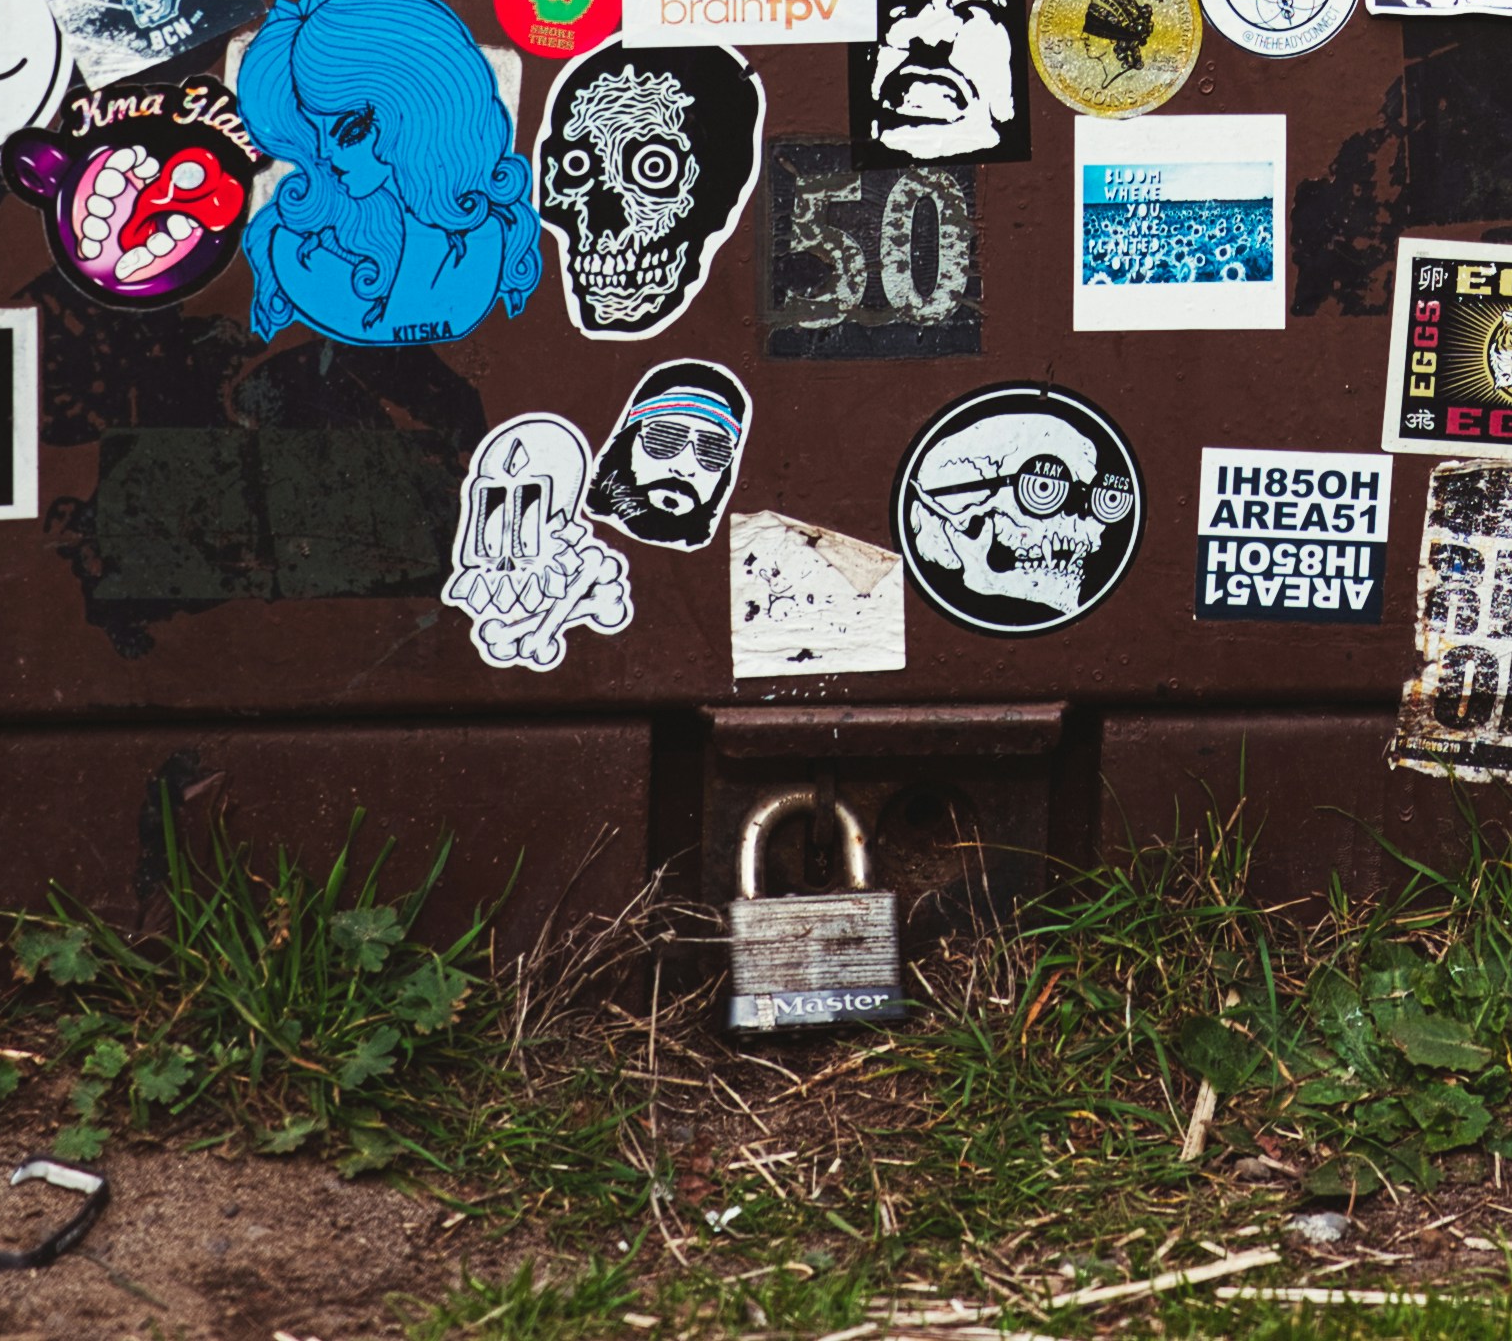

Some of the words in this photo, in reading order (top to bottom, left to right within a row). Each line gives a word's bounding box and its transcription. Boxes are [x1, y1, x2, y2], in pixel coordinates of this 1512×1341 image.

[149, 16, 194, 51] BCN
[529, 25, 576, 40] SMOKE
[1242, 6, 1342, 51] @THEHEADYCONNECT
[528, 34, 576, 51] TREES
[1105, 169, 1161, 184] BLOOM
[1104, 186, 1161, 202] WHERE
[1127, 203, 1160, 218] YOU
[1128, 220, 1160, 235] ARE
[785, 167, 970, 328] 50
[1089, 239, 1160, 254] PLANTED
[392, 320, 454, 342] KITSKA
[1408, 299, 1441, 398] EGGS
[1042, 462, 1064, 478] RAY
[1102, 473, 1130, 491] SPECS
[1209, 499, 1377, 534] AREA51
[1204, 573, 1375, 610] AREA51
[774, 992, 890, 1017] Master
